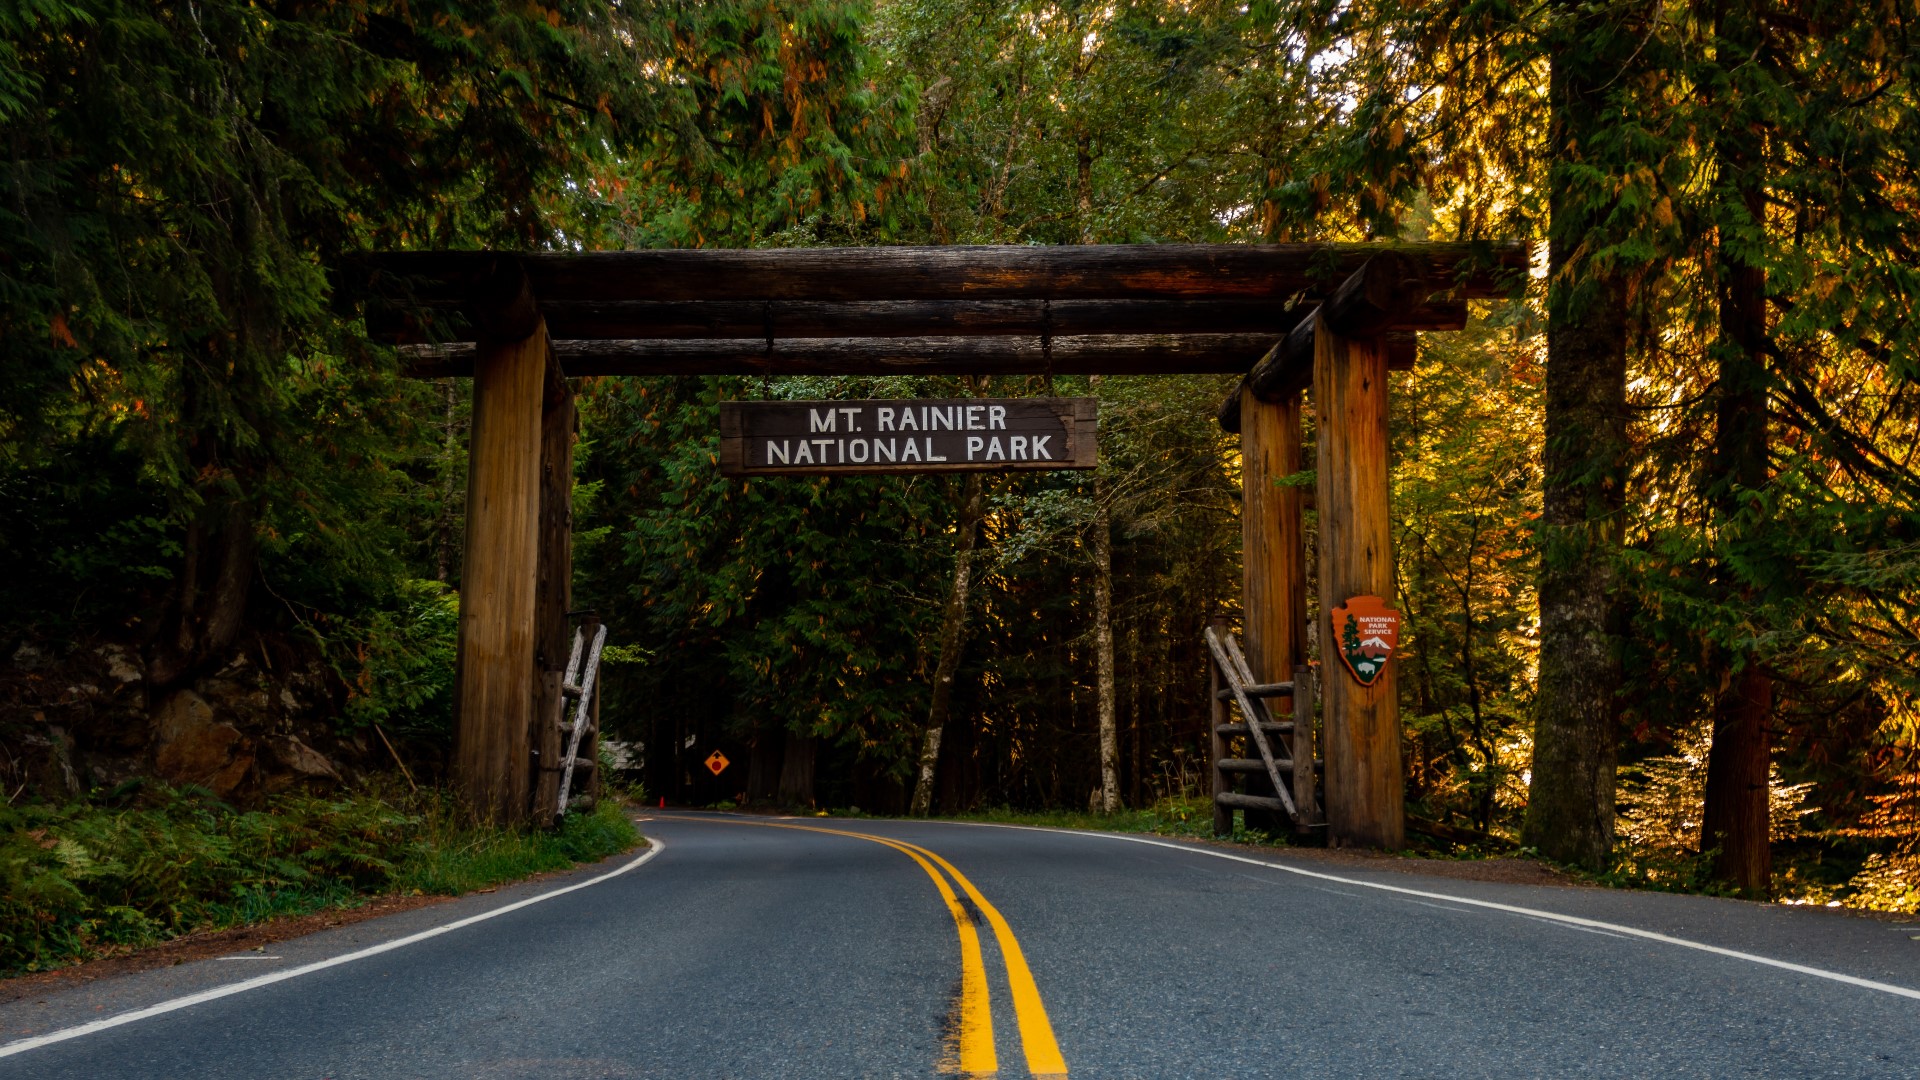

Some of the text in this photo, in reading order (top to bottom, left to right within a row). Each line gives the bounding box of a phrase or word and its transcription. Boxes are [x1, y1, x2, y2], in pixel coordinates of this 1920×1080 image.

[878, 405, 1007, 432] RAINIER
[766, 435, 1053, 465] NATIONAL PARK
